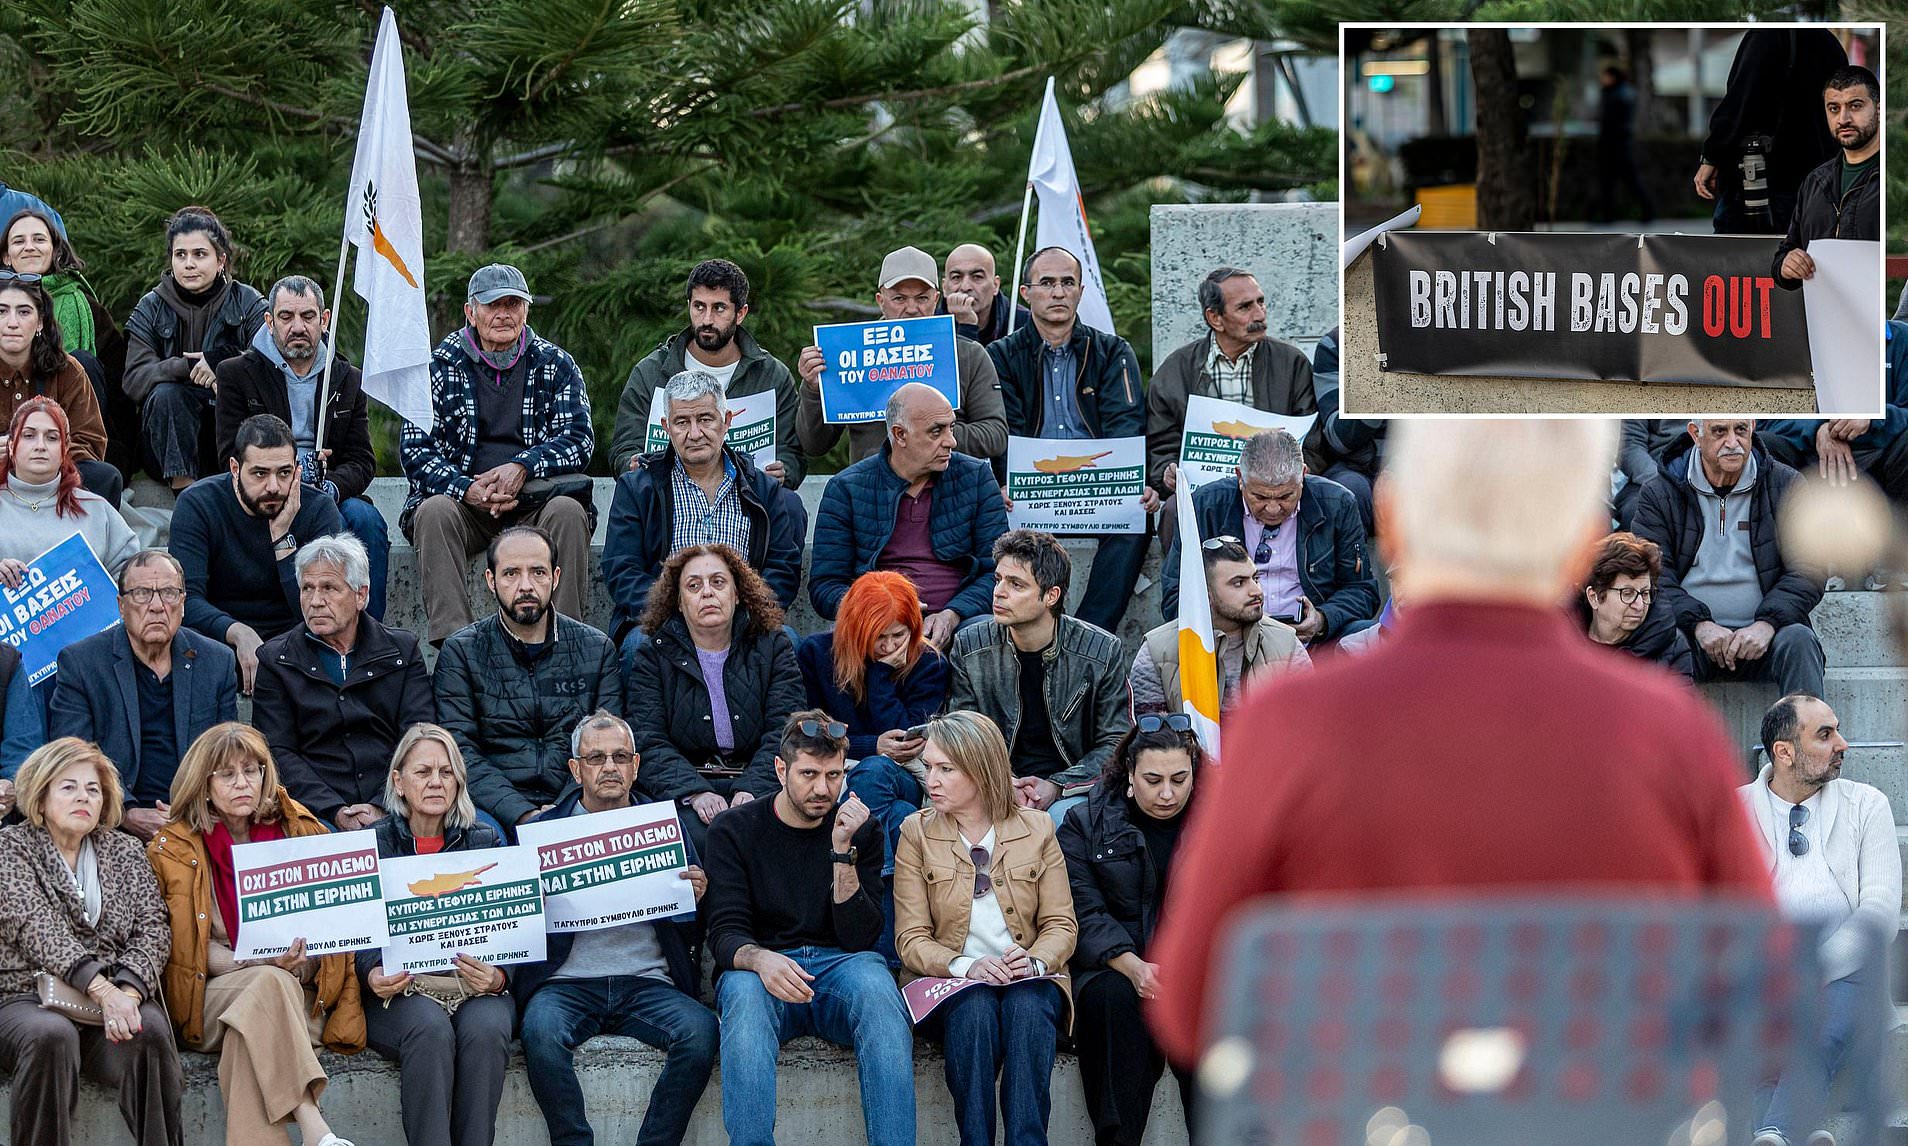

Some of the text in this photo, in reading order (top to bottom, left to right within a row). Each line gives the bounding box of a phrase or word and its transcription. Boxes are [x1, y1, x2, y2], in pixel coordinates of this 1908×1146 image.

[1409, 270, 1776, 340] BRITISH BASES OUT
[863, 326, 906, 346] ΕΞΩ
[839, 343, 934, 369] ΟΙ ΒΑΣΕΙΣ
[838, 363, 935, 385] ΤΟΥ ΘΑΝΑΤΟΥ
[838, 411, 876, 419] ΠΑΓΚΥΠΡΙΟ
[734, 422, 770, 439] ΕΙΡΗΝΗΣ
[748, 437, 770, 451] ΛΑΩΝ
[1190, 435, 1231, 448] ΚΥΠΡΟΣ
[1187, 450, 1240, 464] ΚΑΙ ΣΥΝΕΡΓ
[1014, 470, 1139, 486] ΚΥΠΡΟΣ ΓΕΦΥΡΑ ΕΙΡΗΝΗΣ
[1200, 464, 1223, 473] ΧΩΡΙΣ
[1013, 485, 1140, 500] ΚΑΙ ΣΥΝΕΡΓΑΣΙΑΣ ΤΩΝ ΛΑΩΝ
[1028, 498, 1123, 509] ΧΩΡΙΣ ΞΕΝΟΥΣ ΣΤΡΑΤΟΥΣ
[13, 568, 83, 625] ΒΑΣΕΙΣ
[29, 586, 91, 635] ΘΑΝΑΤΟΥ
[540, 824, 677, 867] ΧΙ ΣΤΟΝ ΠΟΛΕΜΟ
[243, 855, 375, 892] ΟΧΙ ΣΤΟΝ ΠΟΛΕΜΟ
[541, 849, 678, 893] ΝΑΙ ΣΤΗΝ ΕΙΡΗΝΗ
[247, 881, 373, 919] ΝΑΙ ΣΤΗΝ ΕΙΡΗΝΗ
[388, 884, 533, 917] ΚΥΠΡΟΣ ΓΕΦΥΡΑ ΕΙΡΗΝΗΣ
[389, 902, 536, 934] ΚΑΙ ΣΥΝΕΡΓΑΣΙΑΣ ΤΩΝ ΛΑΩΝ
[553, 902, 679, 929] ΠΑΓΚΥΠΡΙΟ ΣΥΜΒΟΥΛΙΟ ΕΙΡΗΝΗΣ
[408, 920, 519, 945] ΧΩΡΙΣ ΞΕΝΟΥΣ ΣΤΡΑΤΟΥΣ
[440, 935, 489, 950] ΚΑΙ ΒΑΣΕΙΣ
[252, 936, 372, 955] ΠΑΓΚΥΠΡΙ ΒΟΥΛΙΟ ΕΙΡΗΝΗΣ
[402, 958, 448, 970] ΠΑΓΚΥΠΡΙΟ
[496, 950, 529, 961] ΕΙΡΗΝΗΣ
